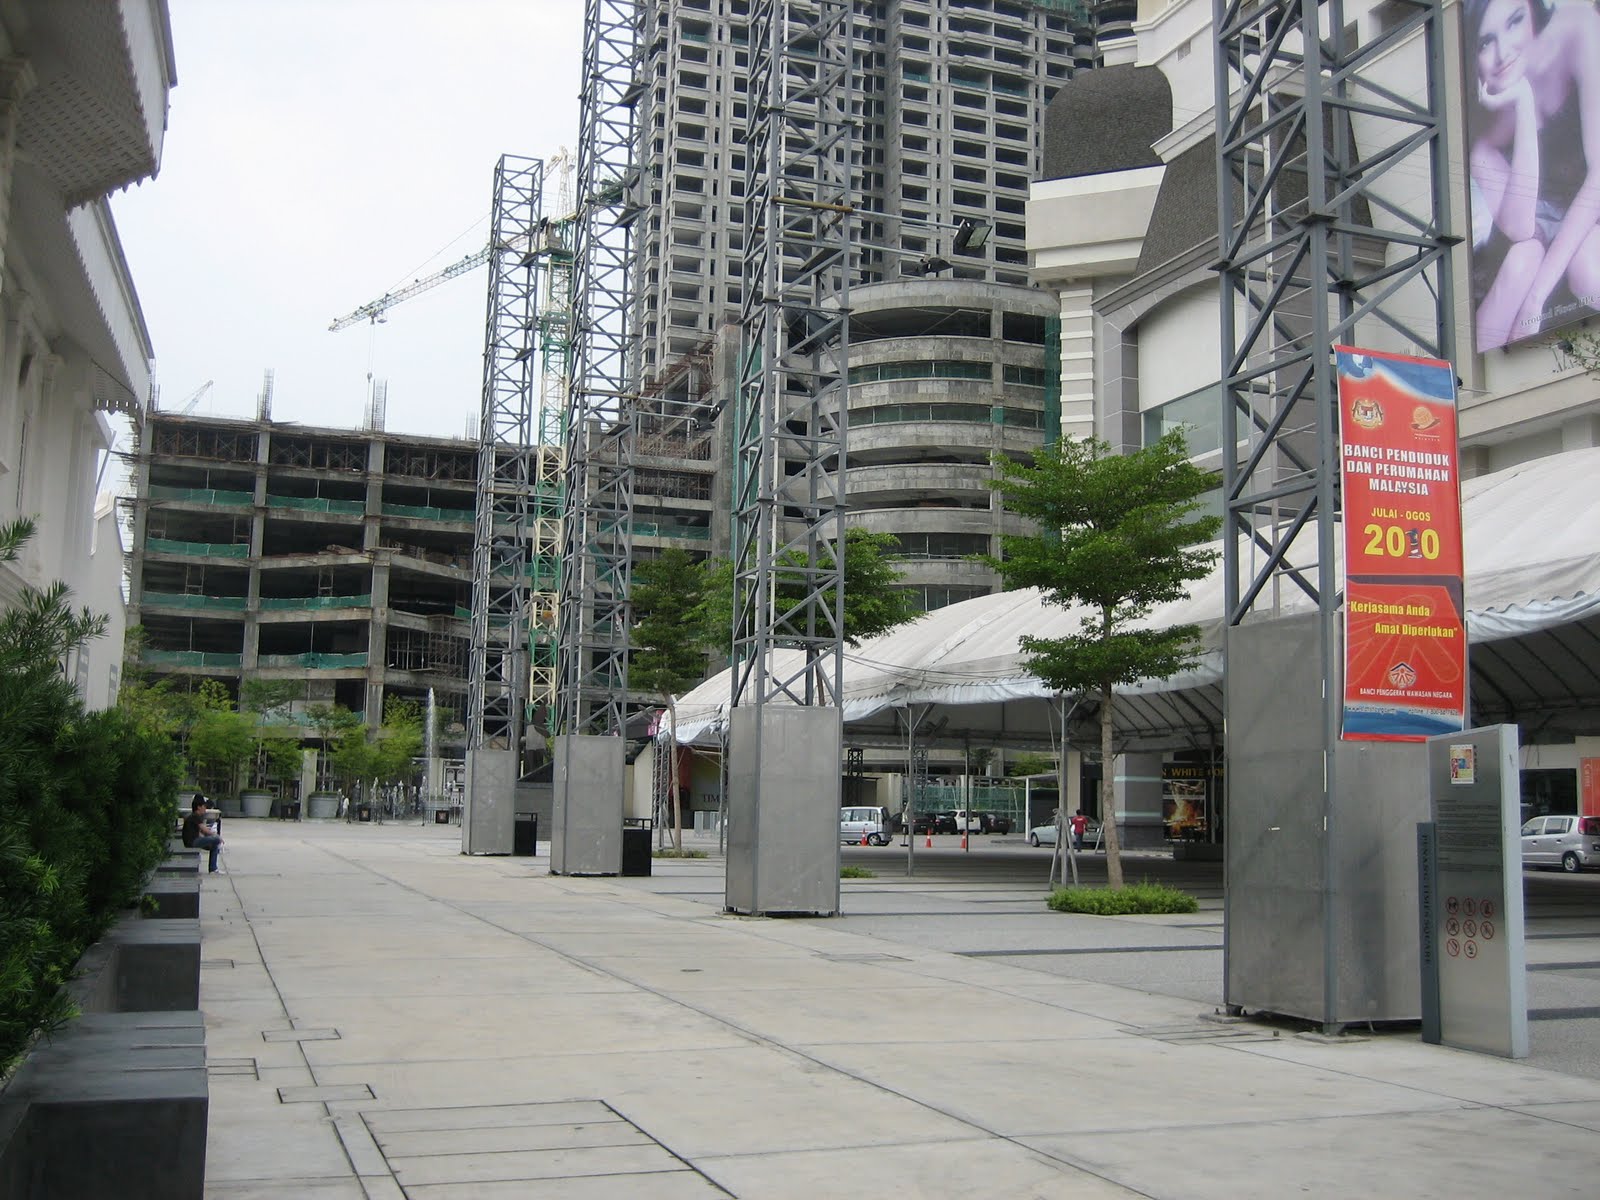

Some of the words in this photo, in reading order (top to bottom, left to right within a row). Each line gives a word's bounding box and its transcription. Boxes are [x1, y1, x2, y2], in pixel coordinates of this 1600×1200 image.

[1344, 444, 1383, 459] BANCI
[1386, 449, 1449, 467] PENDUDUK
[1346, 460, 1372, 474] DAN
[1376, 463, 1449, 482] PERUMAHAN
[1369, 478, 1429, 496] MALAYSIA
[1371, 507, 1398, 519] JULAI
[1405, 510, 1431, 521] OGOS
[1363, 523, 1440, 560] 2010
[1406, 604, 1430, 617] Anda
[1375, 622, 1401, 635] Amat
[1359, 687, 1376, 695] BANCI
[1171, 767, 1205, 777] WHITE
